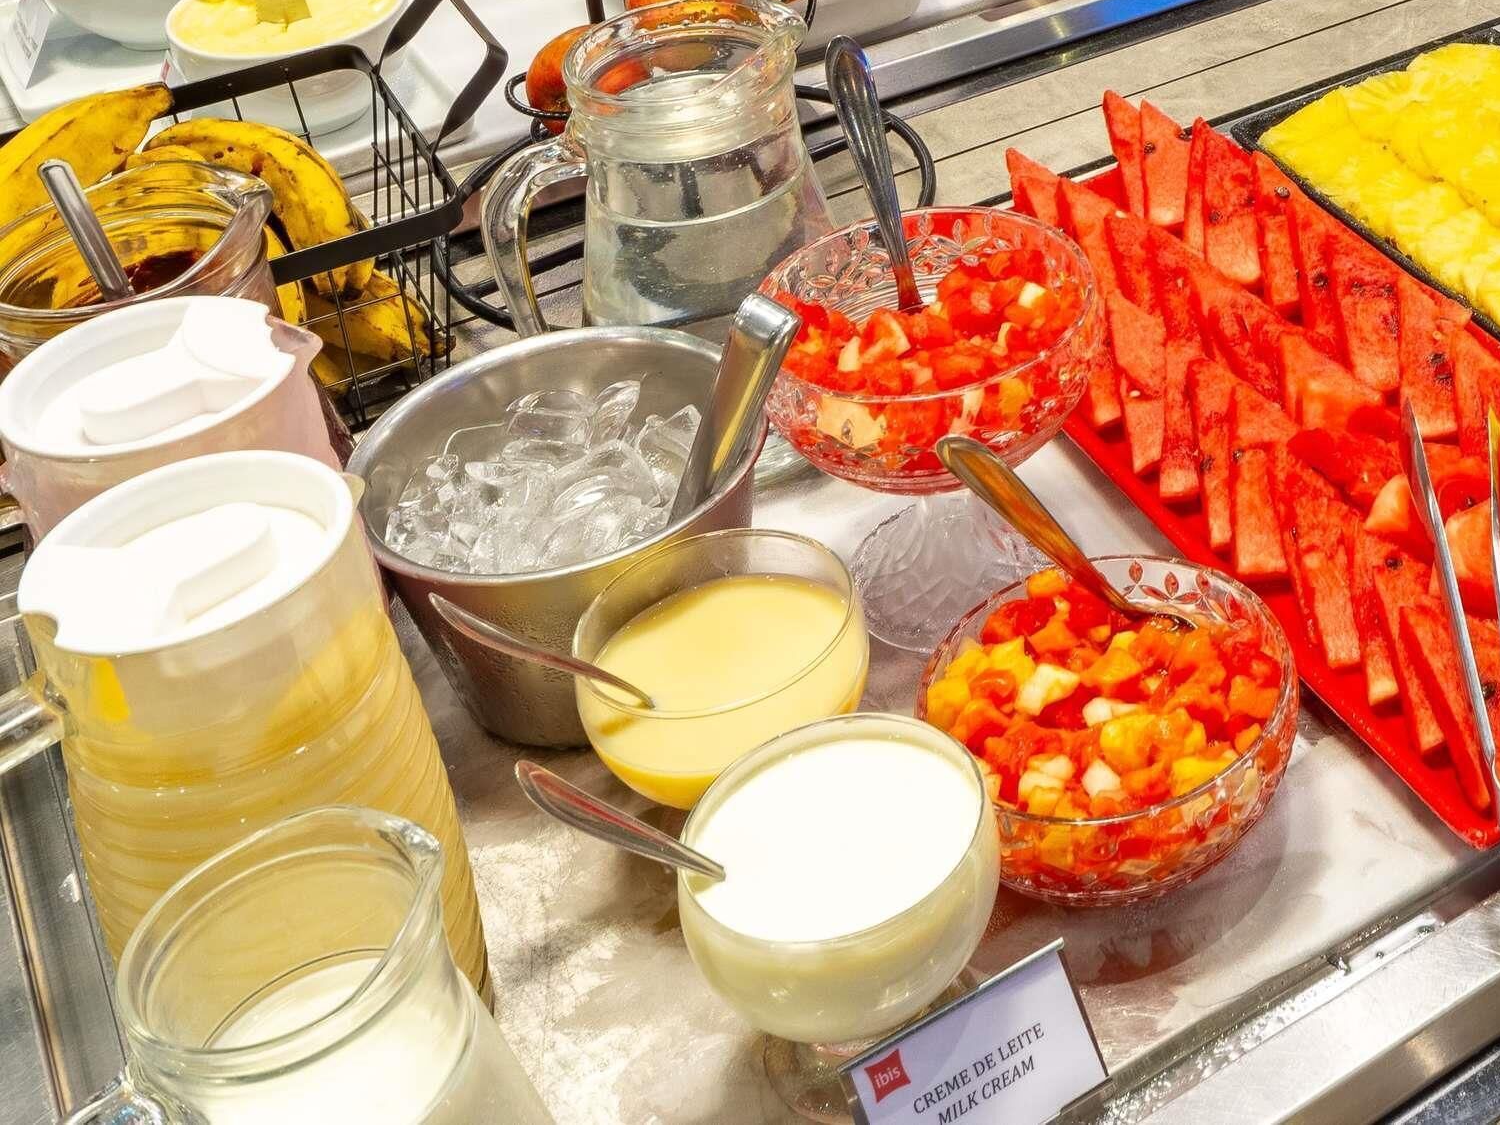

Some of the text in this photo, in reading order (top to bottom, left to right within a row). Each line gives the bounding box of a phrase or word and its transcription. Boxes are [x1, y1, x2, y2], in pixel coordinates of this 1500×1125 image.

[874, 1064, 900, 1089] ibis
[913, 1023, 1045, 1114] CREME DE LEITE
[938, 1055, 1035, 1125] MILK CREAM
